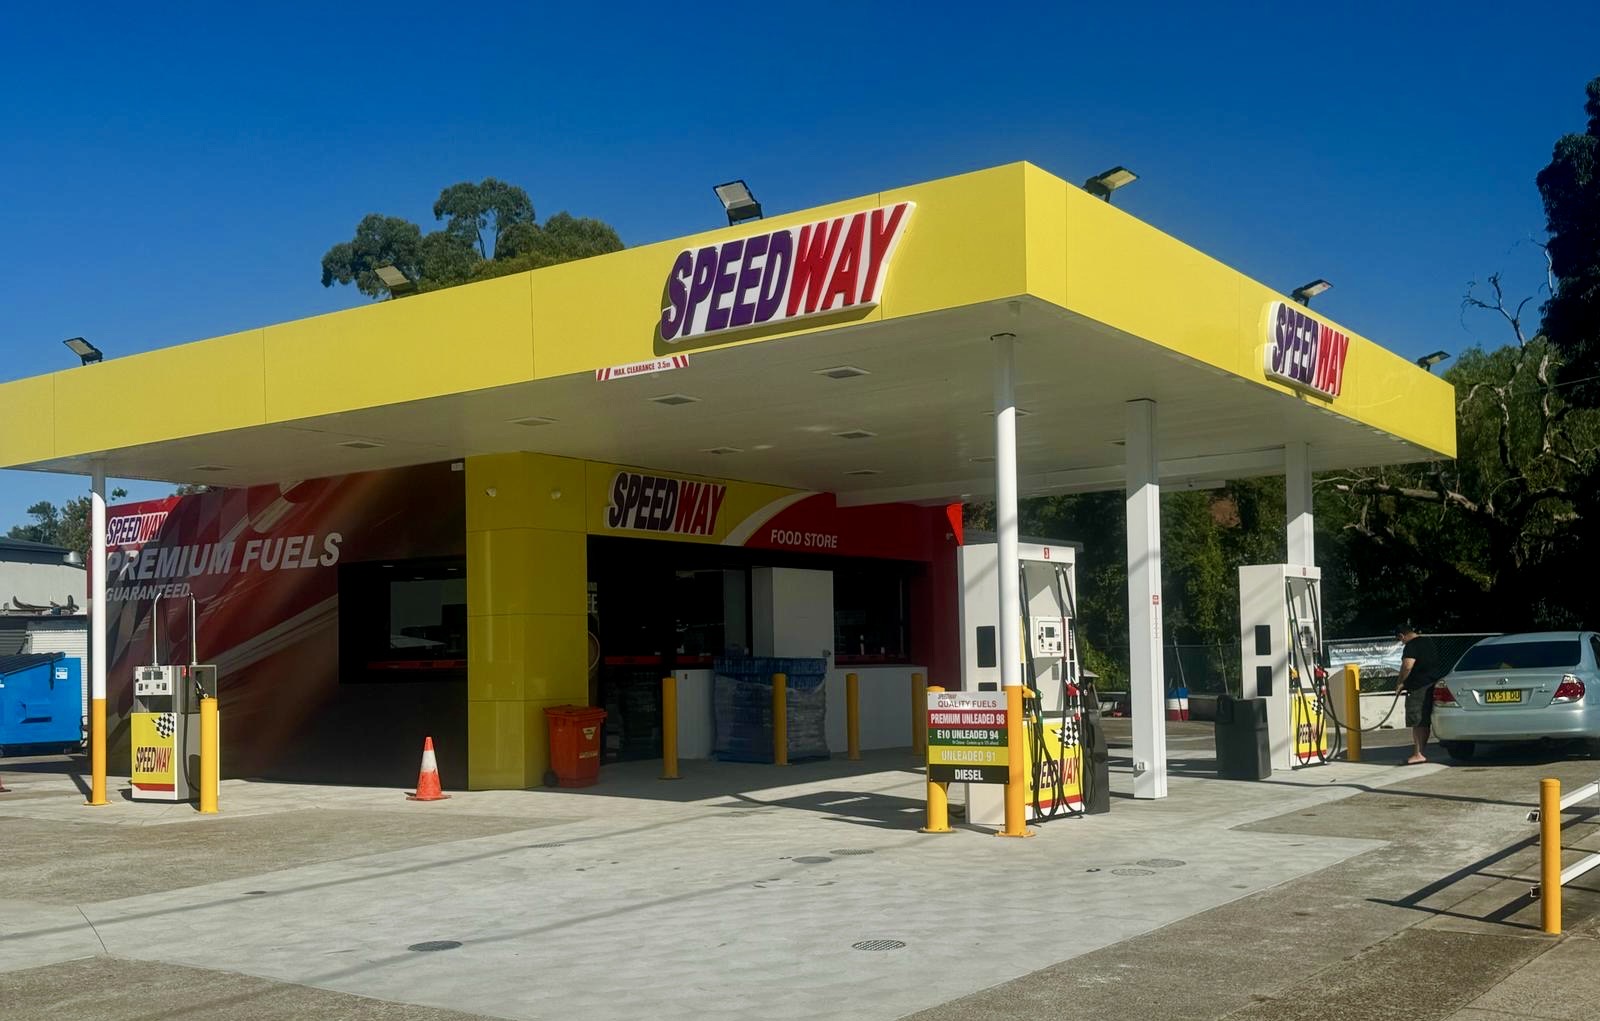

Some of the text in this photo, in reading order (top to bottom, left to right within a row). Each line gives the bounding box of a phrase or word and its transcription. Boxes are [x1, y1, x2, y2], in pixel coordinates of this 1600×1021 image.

[659, 202, 909, 341] SPEEDWAY
[1271, 302, 1350, 397] SPEEDWAY
[626, 363, 655, 374] CLEARANCE
[608, 471, 728, 536] SPEEDWAY
[106, 512, 167, 545] SPEEDWAY
[770, 528, 838, 549] FOOD STORE
[106, 531, 343, 580] PREMIUM FUELS
[106, 582, 190, 602] GUARANTEED
[937, 700, 997, 708] QUALITY FUELS
[930, 713, 1005, 725] PREMIUM UNLEADED 98
[937, 729, 999, 740] E10 UNLEADED 94
[135, 746, 172, 773] SPEEDWAY
[942, 749, 996, 762] UNLEADED 91
[954, 768, 984, 781] DIESEL
